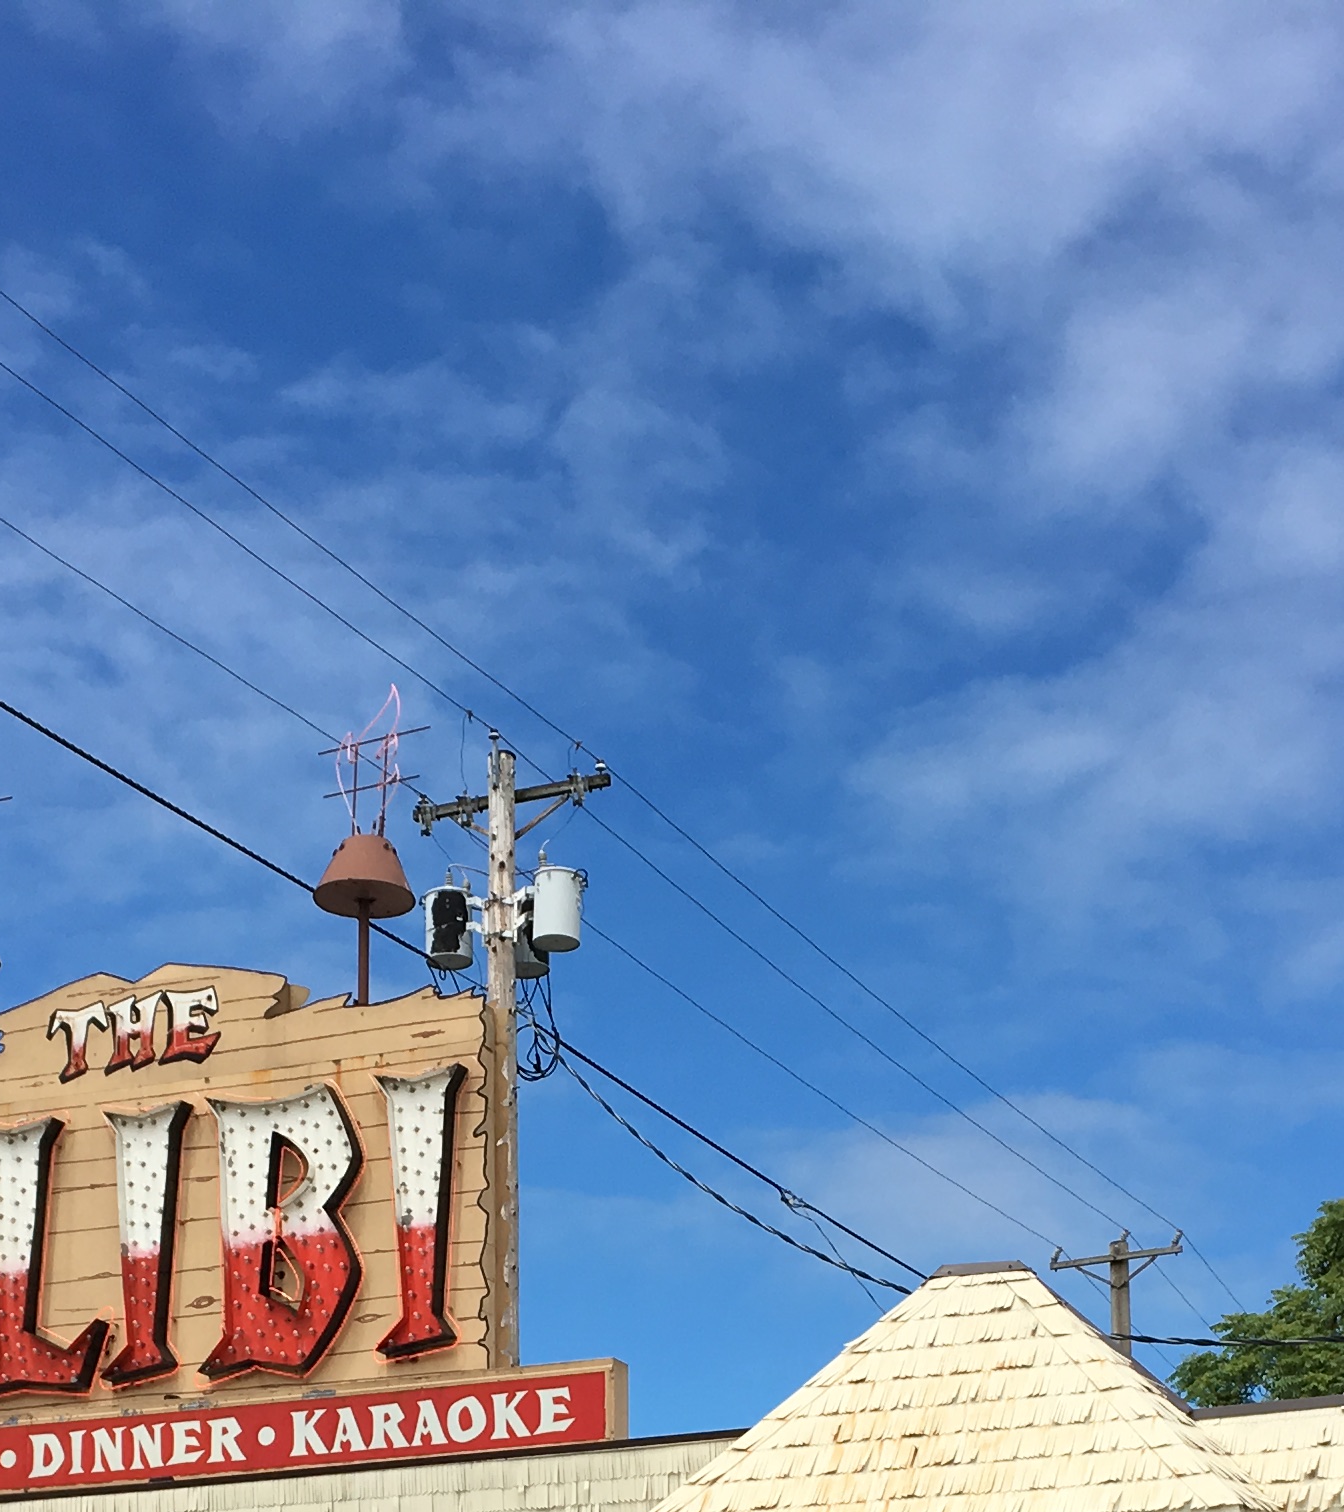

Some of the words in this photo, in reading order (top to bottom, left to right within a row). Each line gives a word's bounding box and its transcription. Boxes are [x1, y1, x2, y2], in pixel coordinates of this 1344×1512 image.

[46, 985, 221, 1084] THE
[28, 1417, 246, 1479] DINNER
[289, 1386, 576, 1458] KARAOKE
